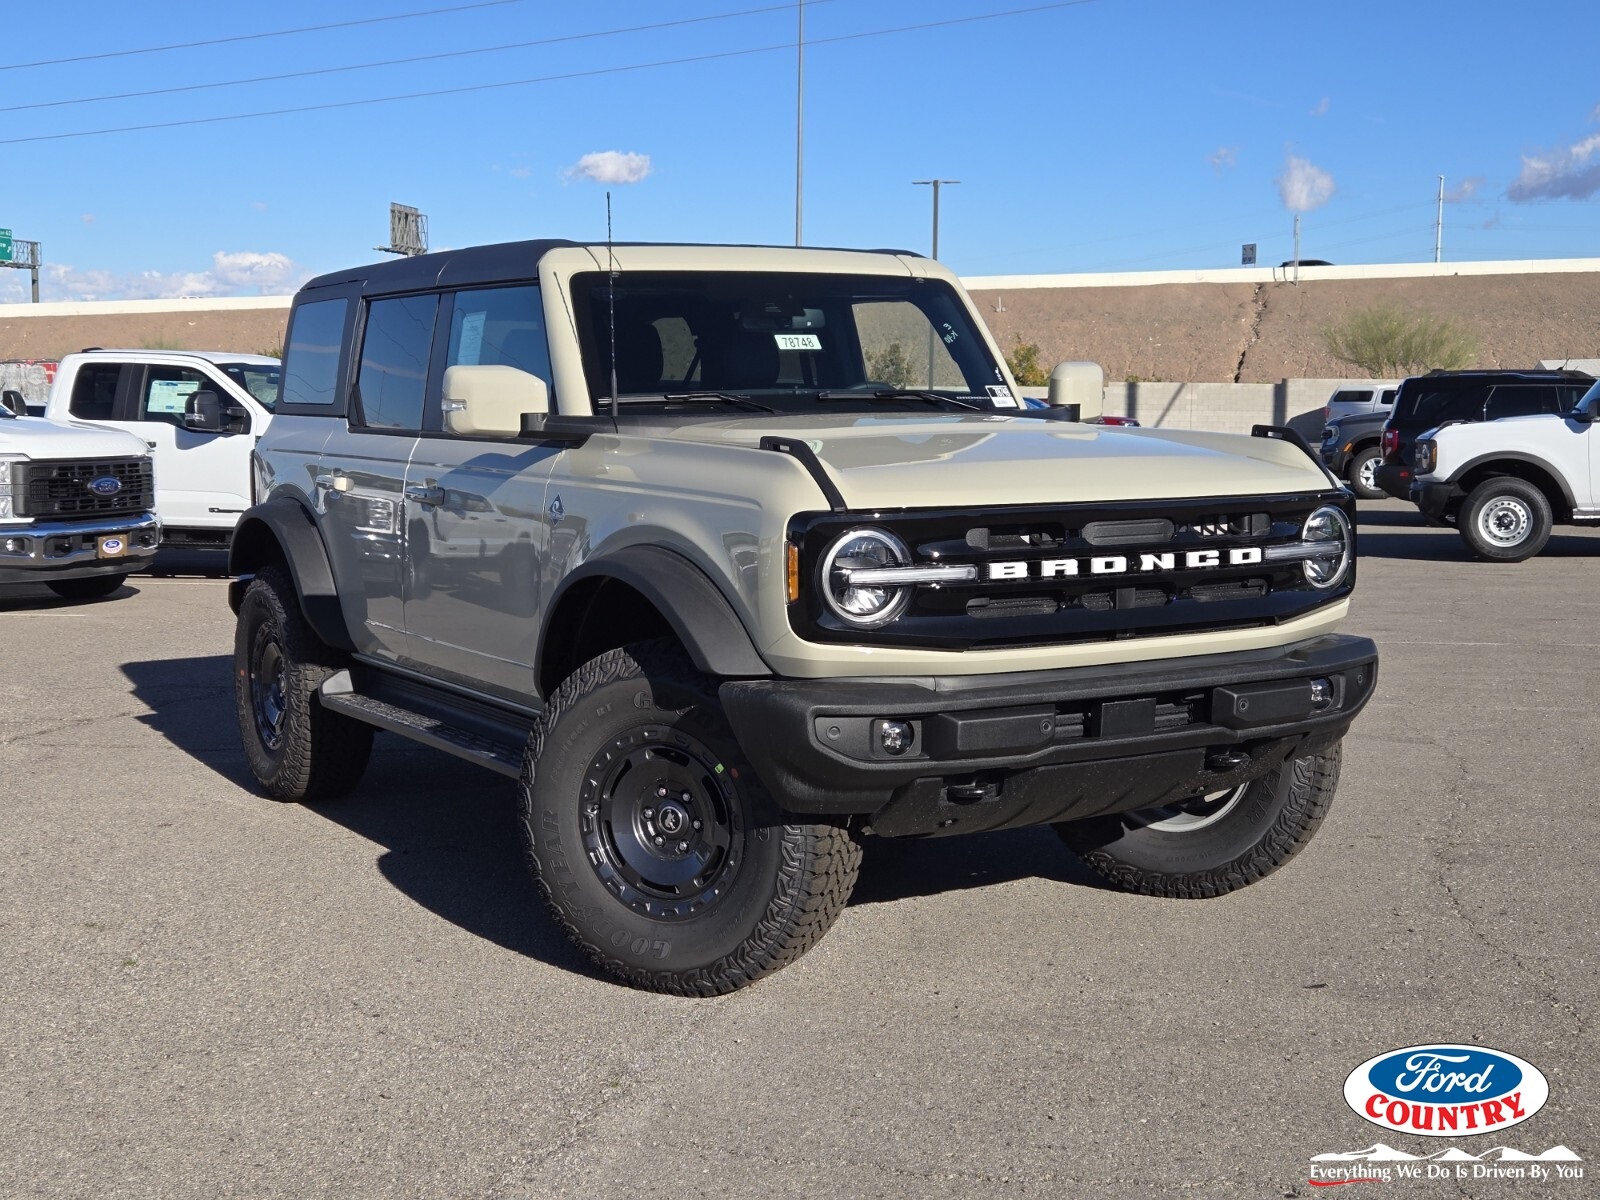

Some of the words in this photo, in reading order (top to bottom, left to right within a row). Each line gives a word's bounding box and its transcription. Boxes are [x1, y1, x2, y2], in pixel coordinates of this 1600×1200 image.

[781, 337, 815, 348] 78748
[988, 547, 1262, 580] BRONCO
[541, 808, 671, 960] GOODYEAR
